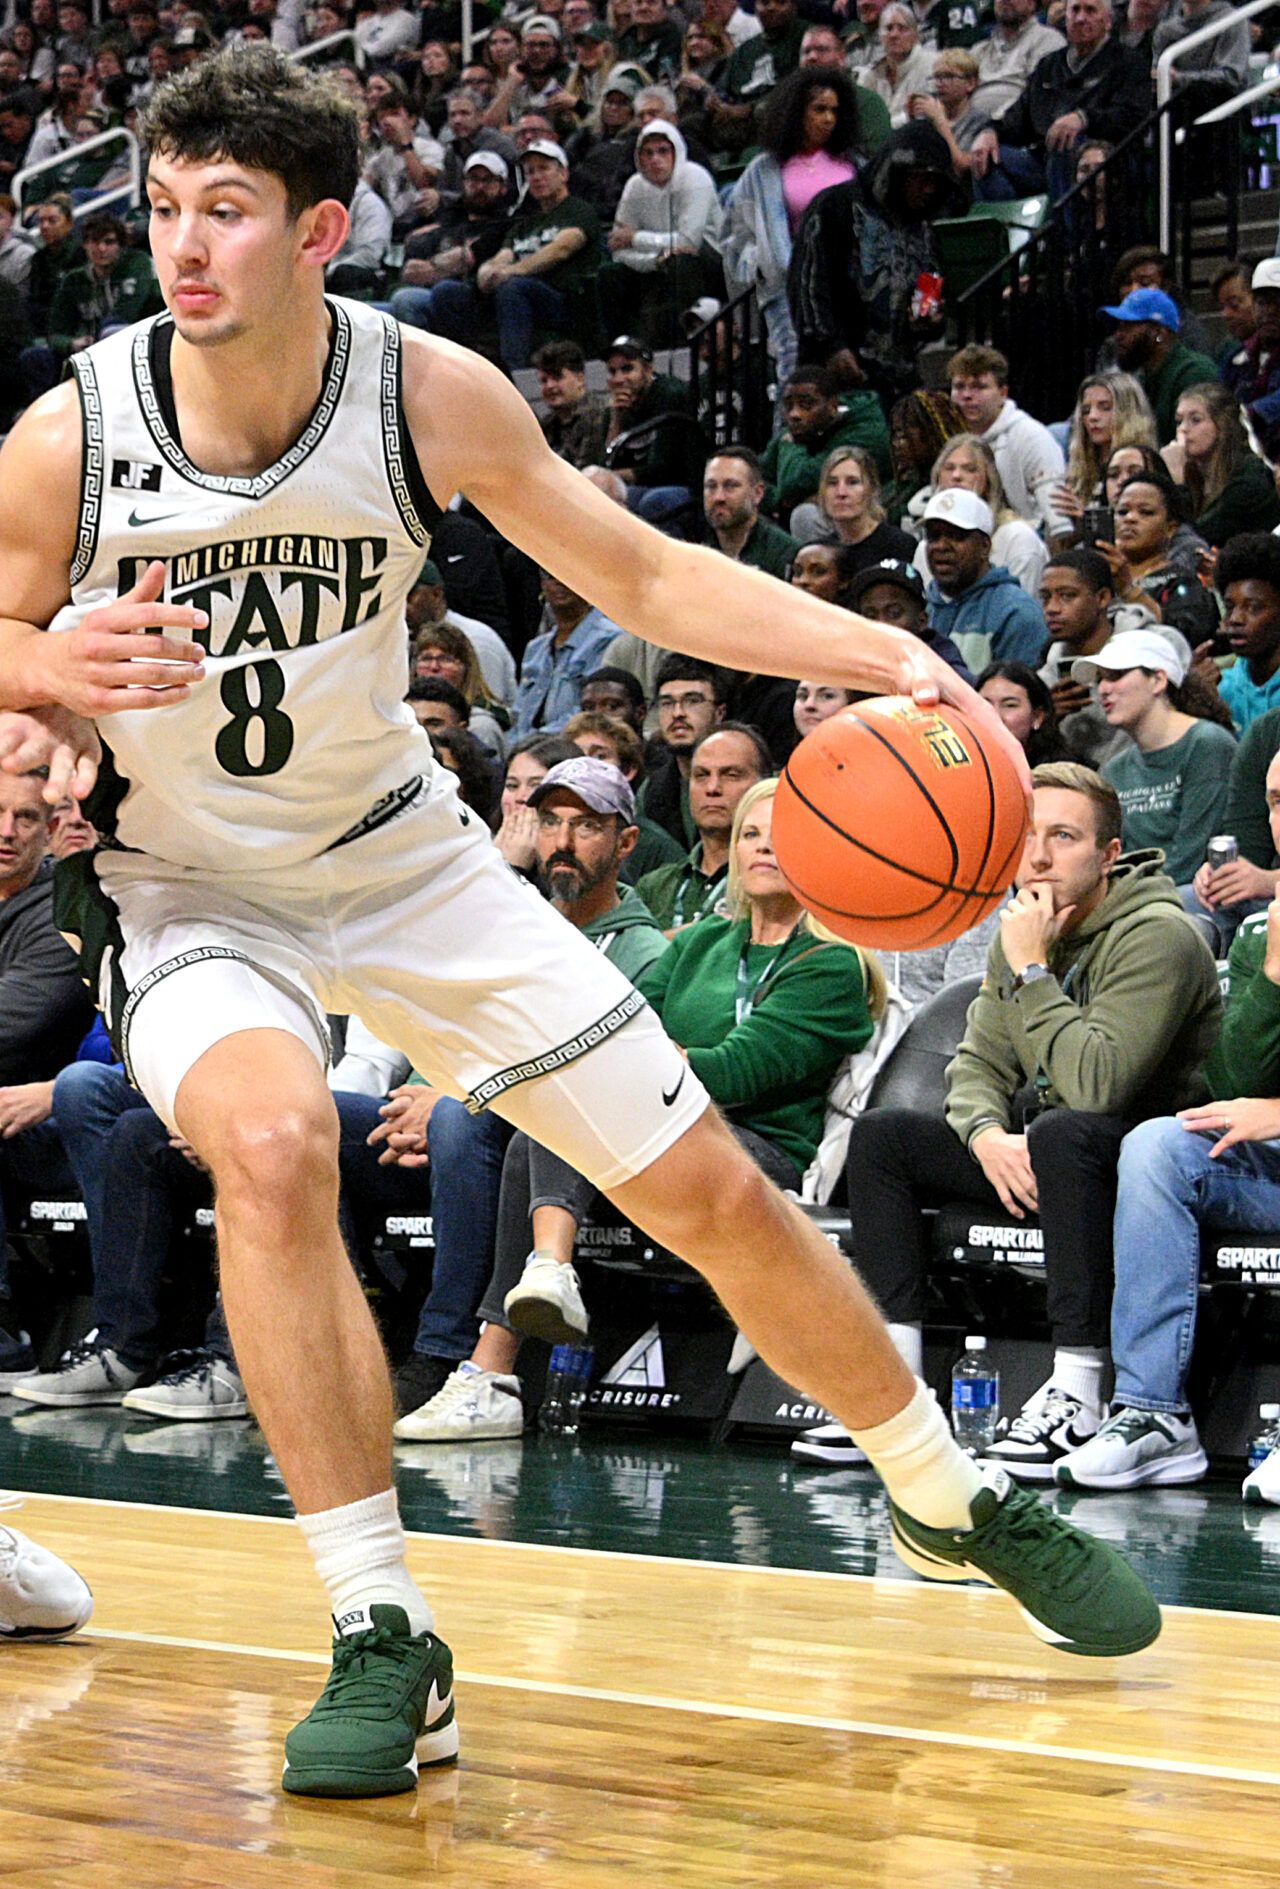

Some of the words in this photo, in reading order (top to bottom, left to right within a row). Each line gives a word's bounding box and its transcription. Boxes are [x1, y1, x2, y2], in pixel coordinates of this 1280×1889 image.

[948, 6, 977, 29] 24
[120, 461, 154, 489] JF
[176, 538, 335, 586] MICHIGAN
[215, 657, 295, 777] 8
[1217, 1247, 1280, 1270] SPART
